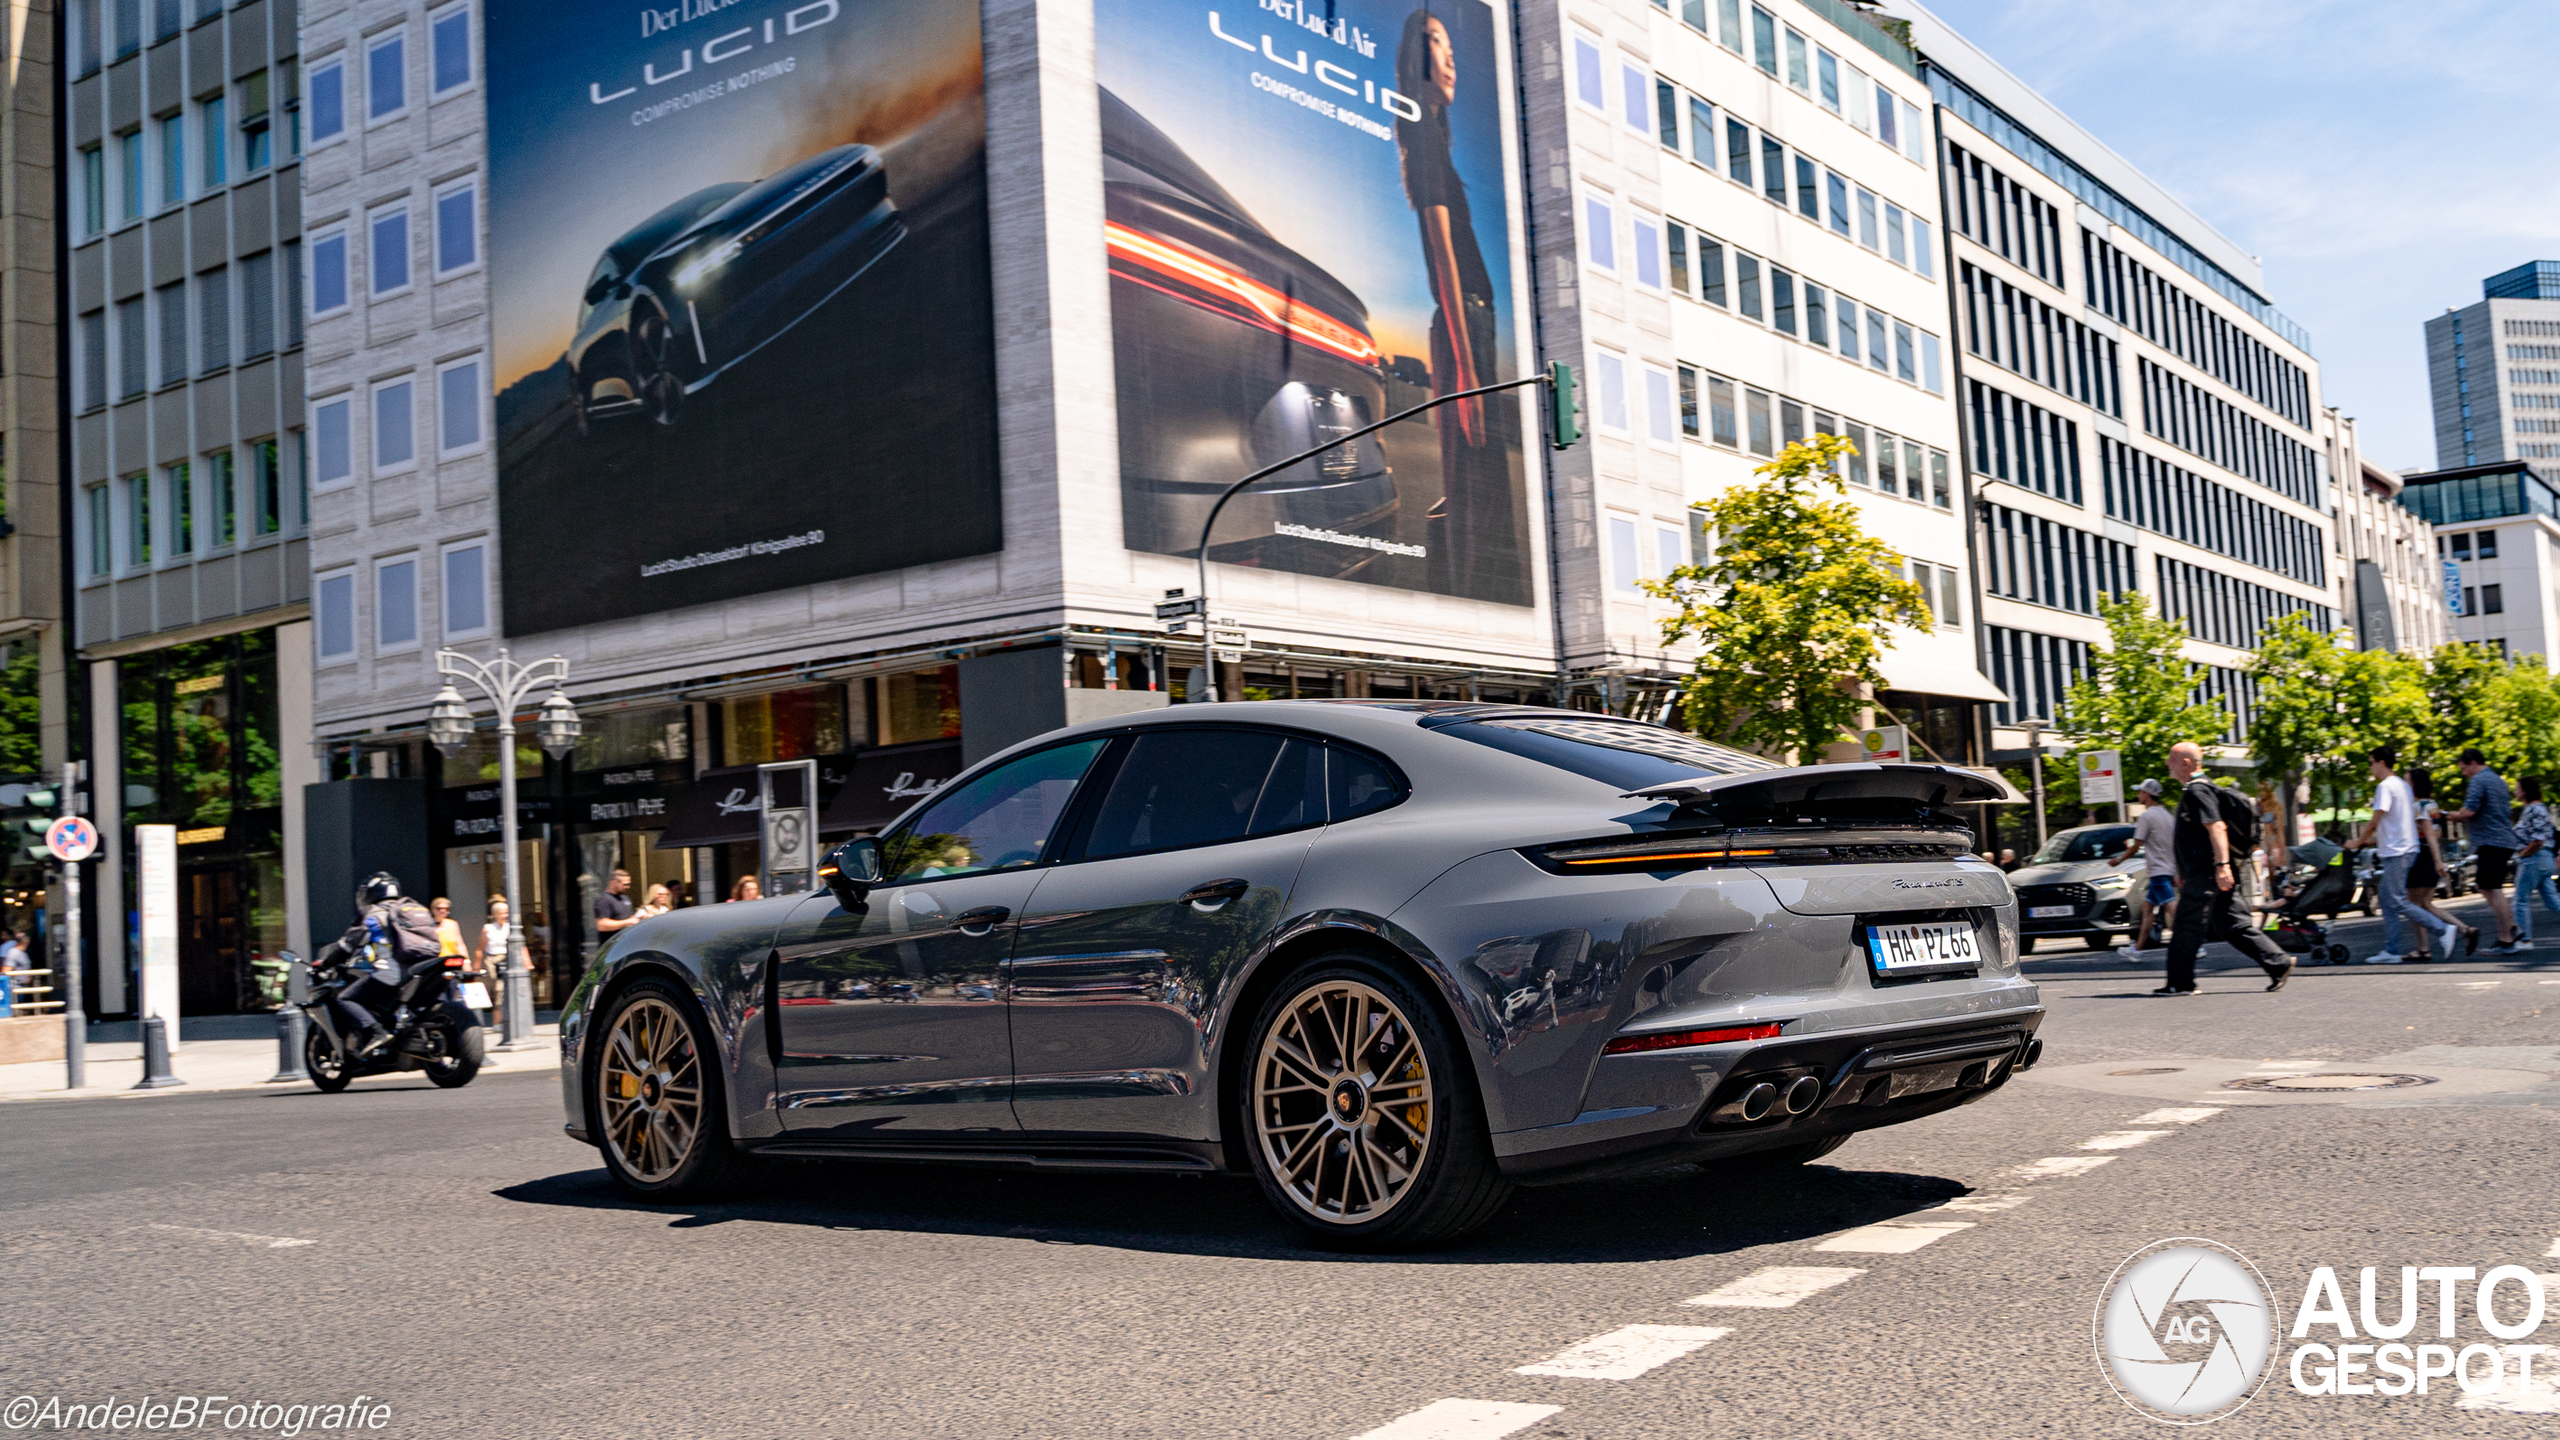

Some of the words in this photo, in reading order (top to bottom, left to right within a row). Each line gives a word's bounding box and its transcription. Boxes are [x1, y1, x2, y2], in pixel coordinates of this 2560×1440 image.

[641, 8, 679, 38] Der
[681, 0, 743, 23] Luc
[1296, 0, 1347, 45] Lucid
[1348, 26, 1377, 59] Air
[590, 0, 839, 104] LUCID
[1208, 11, 1421, 122] LUCID
[631, 80, 725, 127] COMPROMISE
[726, 56, 797, 93] NOTHING
[1250, 71, 1336, 119] COMPROMISE
[1337, 101, 1392, 141] NOTHING
[807, 529, 825, 545] 90
[637, 798, 666, 815] PEPE
[1876, 952, 1882, 963] D
[1886, 929, 1917, 963] HA
[1921, 928, 1950, 960] PZ
[1950, 926, 1971, 958] 66
